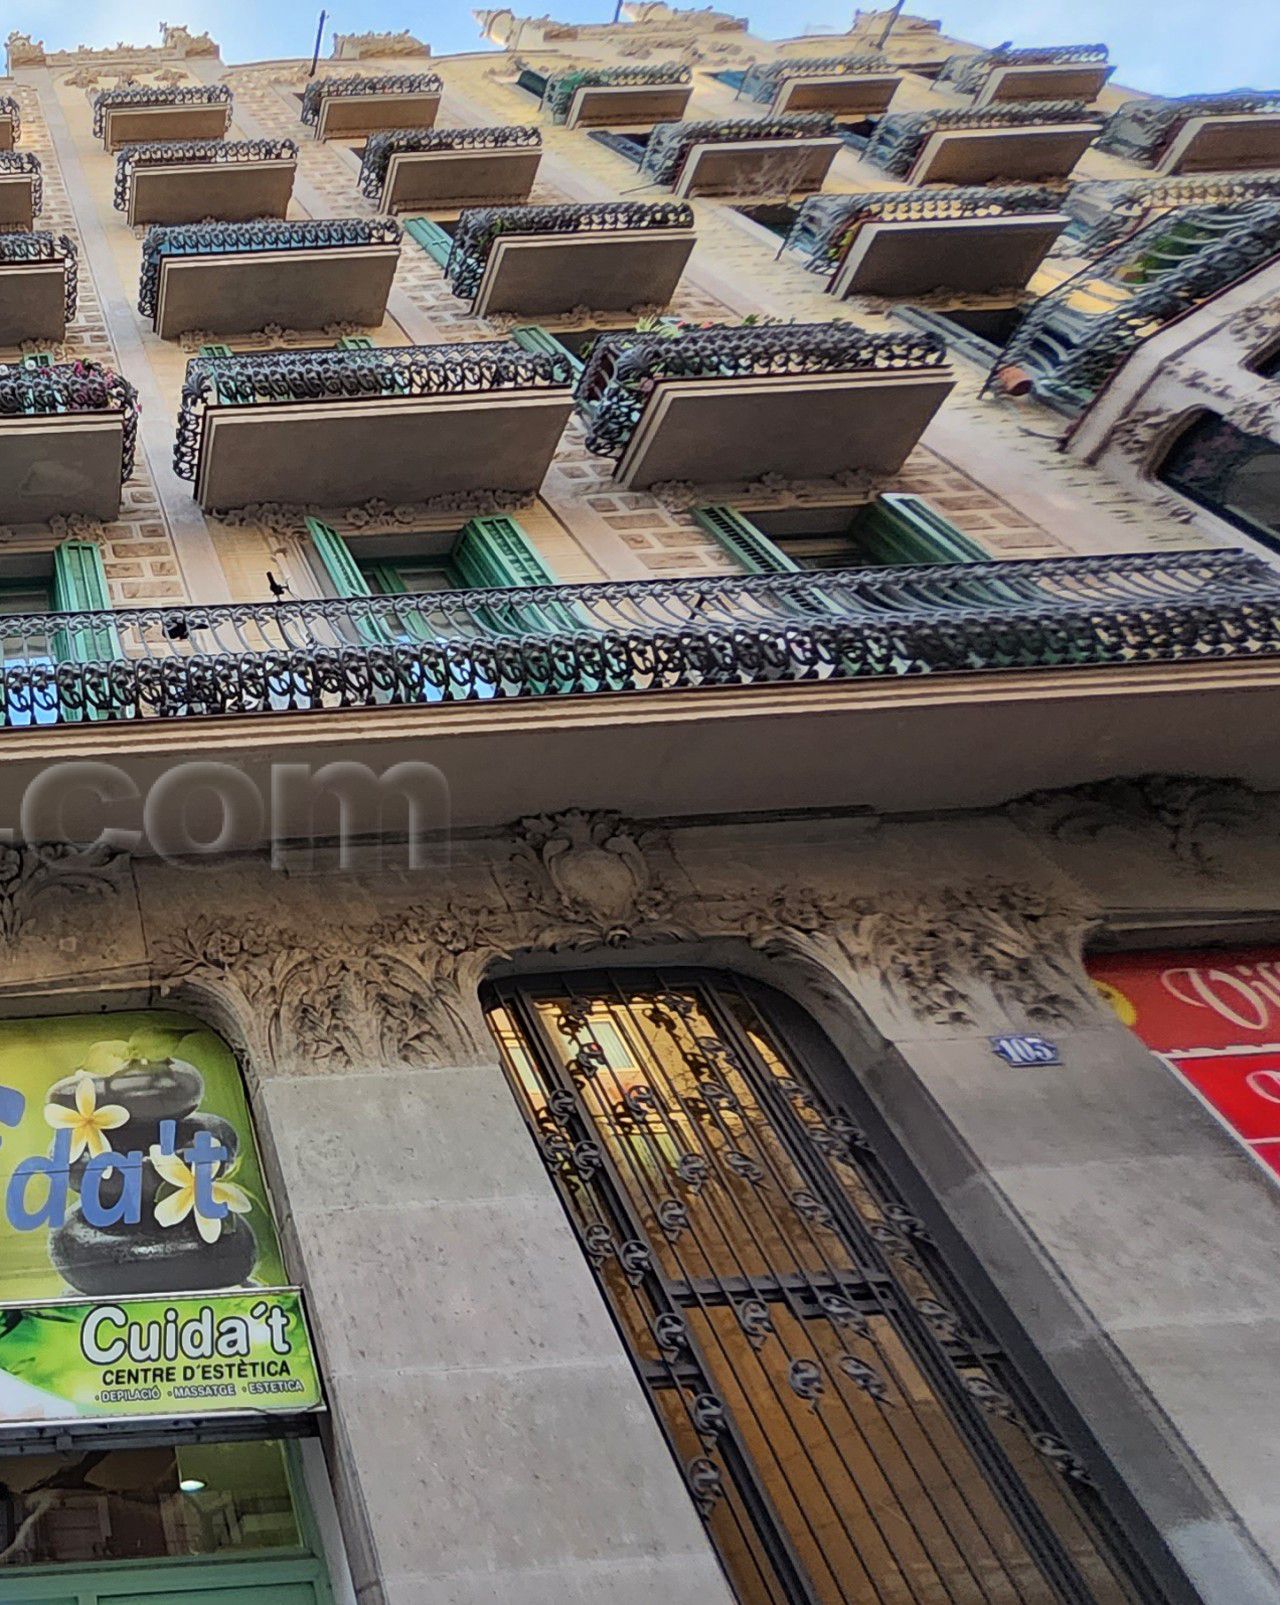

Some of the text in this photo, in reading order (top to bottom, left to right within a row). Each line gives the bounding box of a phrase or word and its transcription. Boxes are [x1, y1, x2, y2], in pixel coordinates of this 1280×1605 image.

[999, 1038, 1056, 1062] 105
[102, 1366, 176, 1386] CENTRE
[173, 1383, 237, 1399] MASSATGE
